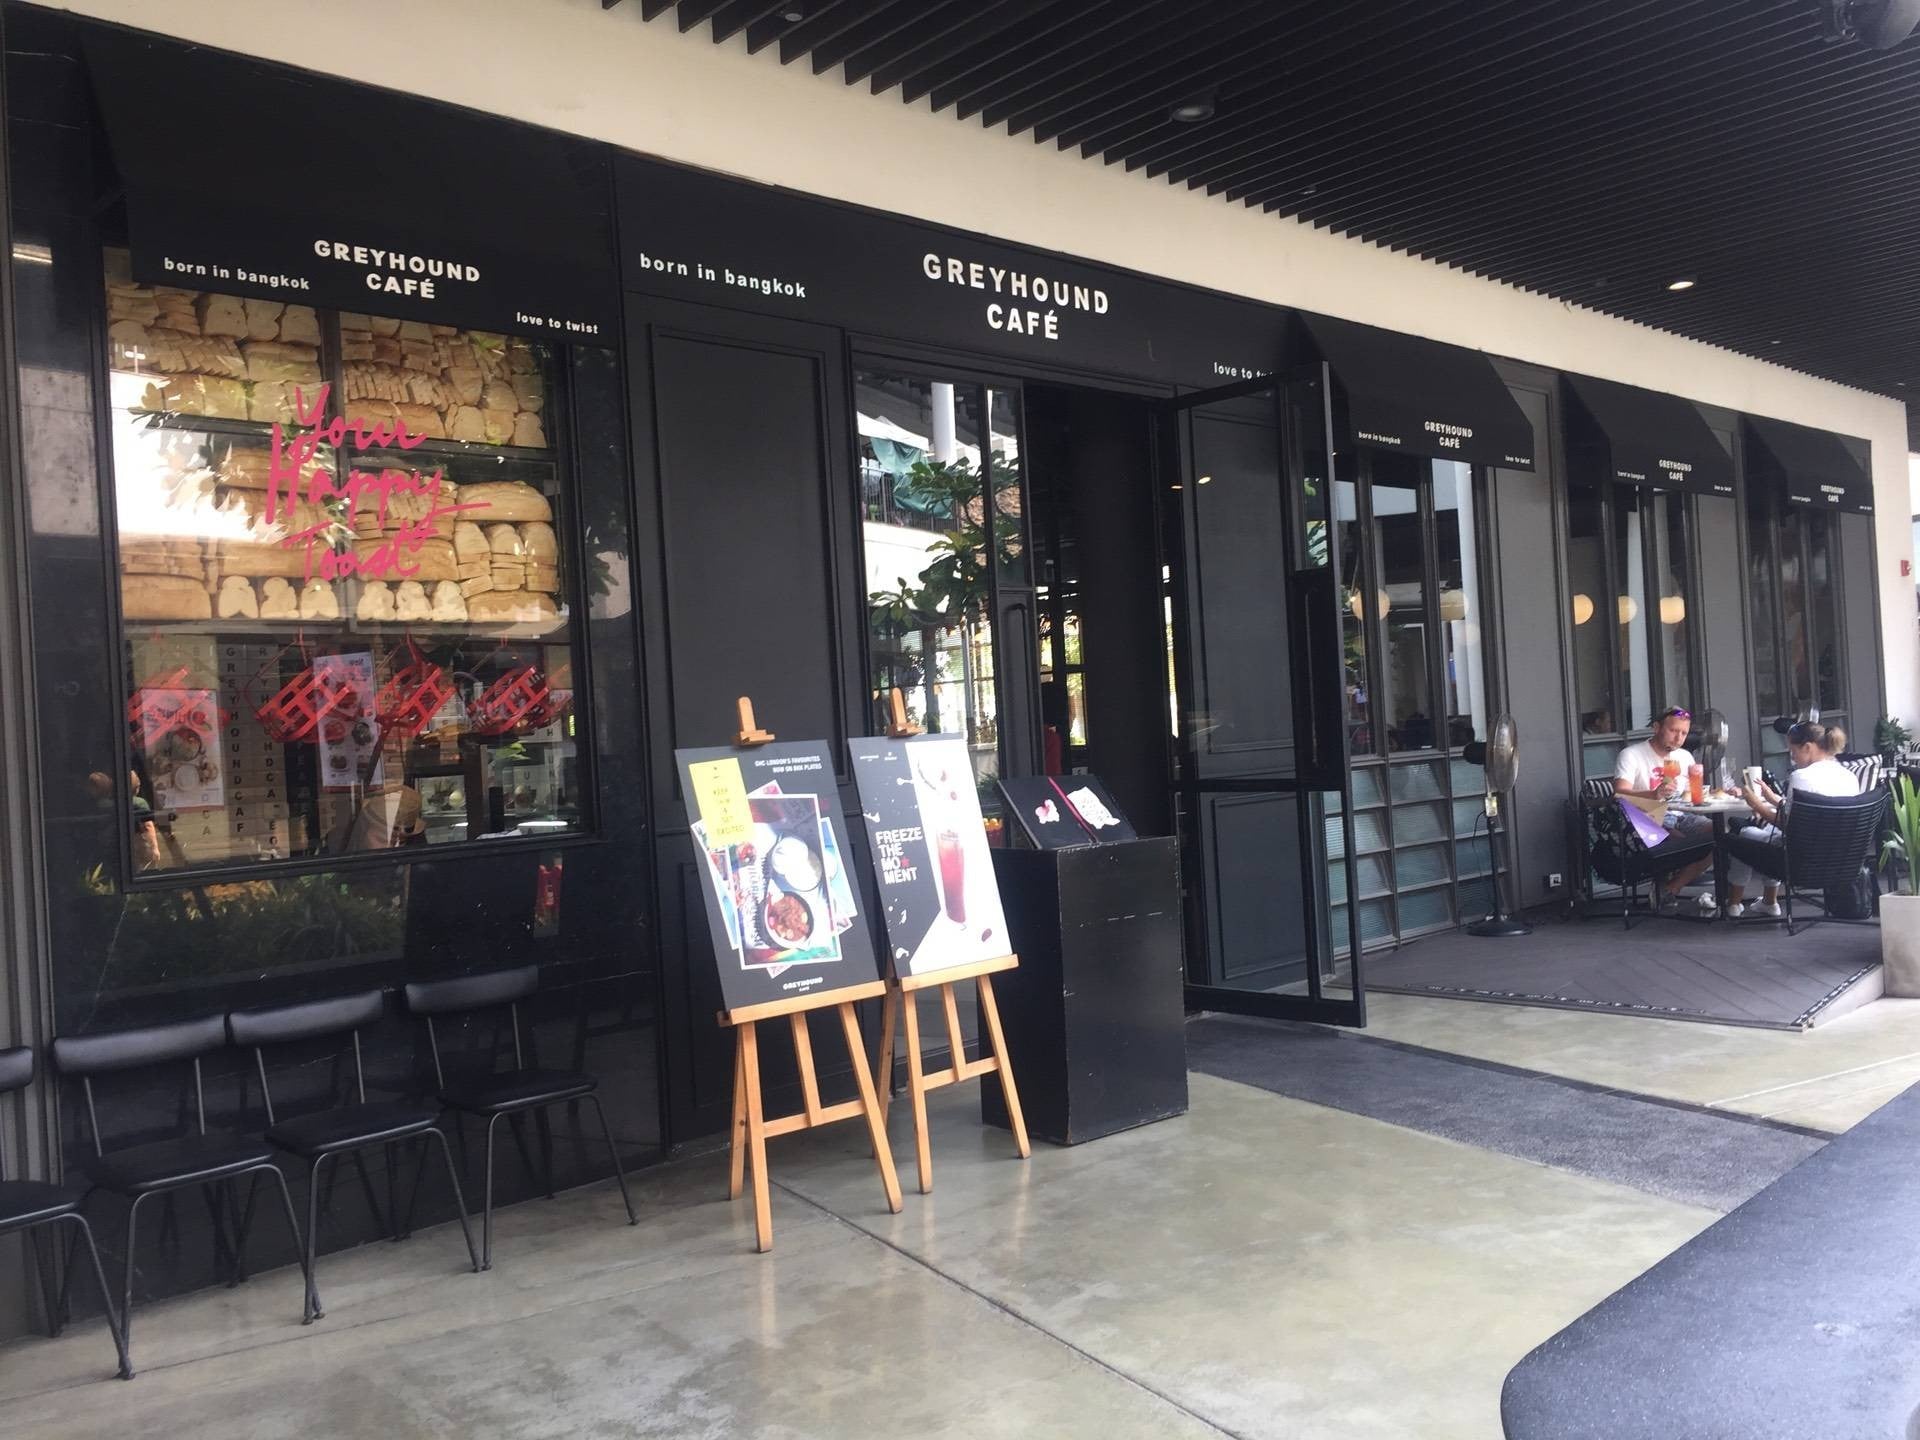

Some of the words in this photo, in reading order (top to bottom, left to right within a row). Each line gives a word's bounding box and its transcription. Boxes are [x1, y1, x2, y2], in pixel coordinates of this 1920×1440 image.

[314, 239, 481, 282] GREYHOUND
[164, 257, 206, 275] born
[212, 264, 230, 279] in
[237, 268, 310, 291] bangkok
[365, 272, 436, 300] CAFÉ
[640, 252, 688, 276] born
[697, 263, 716, 281] in
[725, 269, 806, 298] bangkok
[922, 252, 1110, 315] GREYHOUND
[516, 311, 543, 326] love
[548, 317, 561, 329] to
[566, 320, 599, 335] twist
[986, 303, 1059, 340] CAFÉ
[1213, 361, 1237, 377] love
[1241, 367, 1253, 380] to
[288, 383, 428, 463] Your
[1424, 420, 1473, 438] GREYHOUND
[1439, 436, 1460, 449] CAFÉ
[265, 422, 492, 531] Happy
[875, 826, 923, 845] FREEZE
[878, 842, 904, 858] THE
[881, 856, 901, 871] MO
[884, 866, 917, 885] MENT
[783, 976, 824, 991] GREYHOUND
